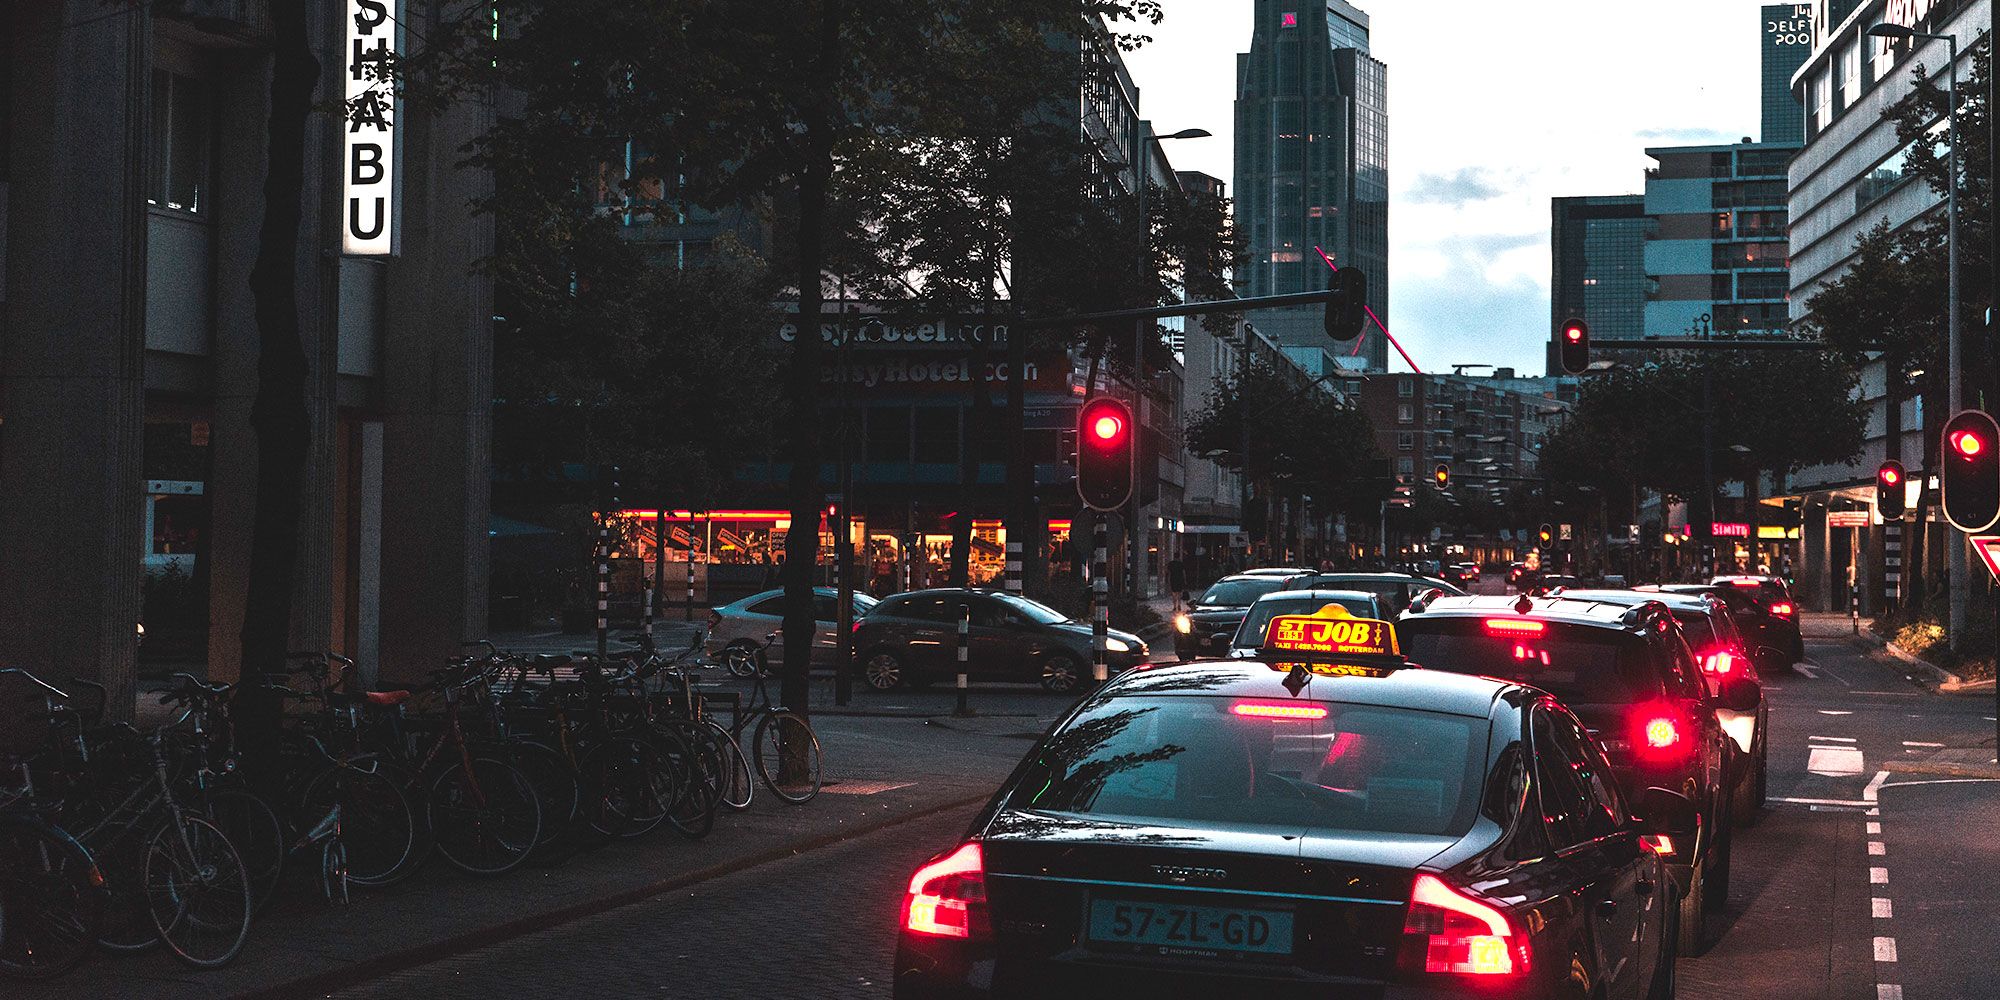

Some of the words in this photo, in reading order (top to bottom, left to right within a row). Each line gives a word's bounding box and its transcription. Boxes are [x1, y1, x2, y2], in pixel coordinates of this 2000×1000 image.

[350, 0, 387, 240] SHABU
[1312, 622, 1371, 644] JOB
[1112, 905, 1271, 946] 57-ZL-GD
